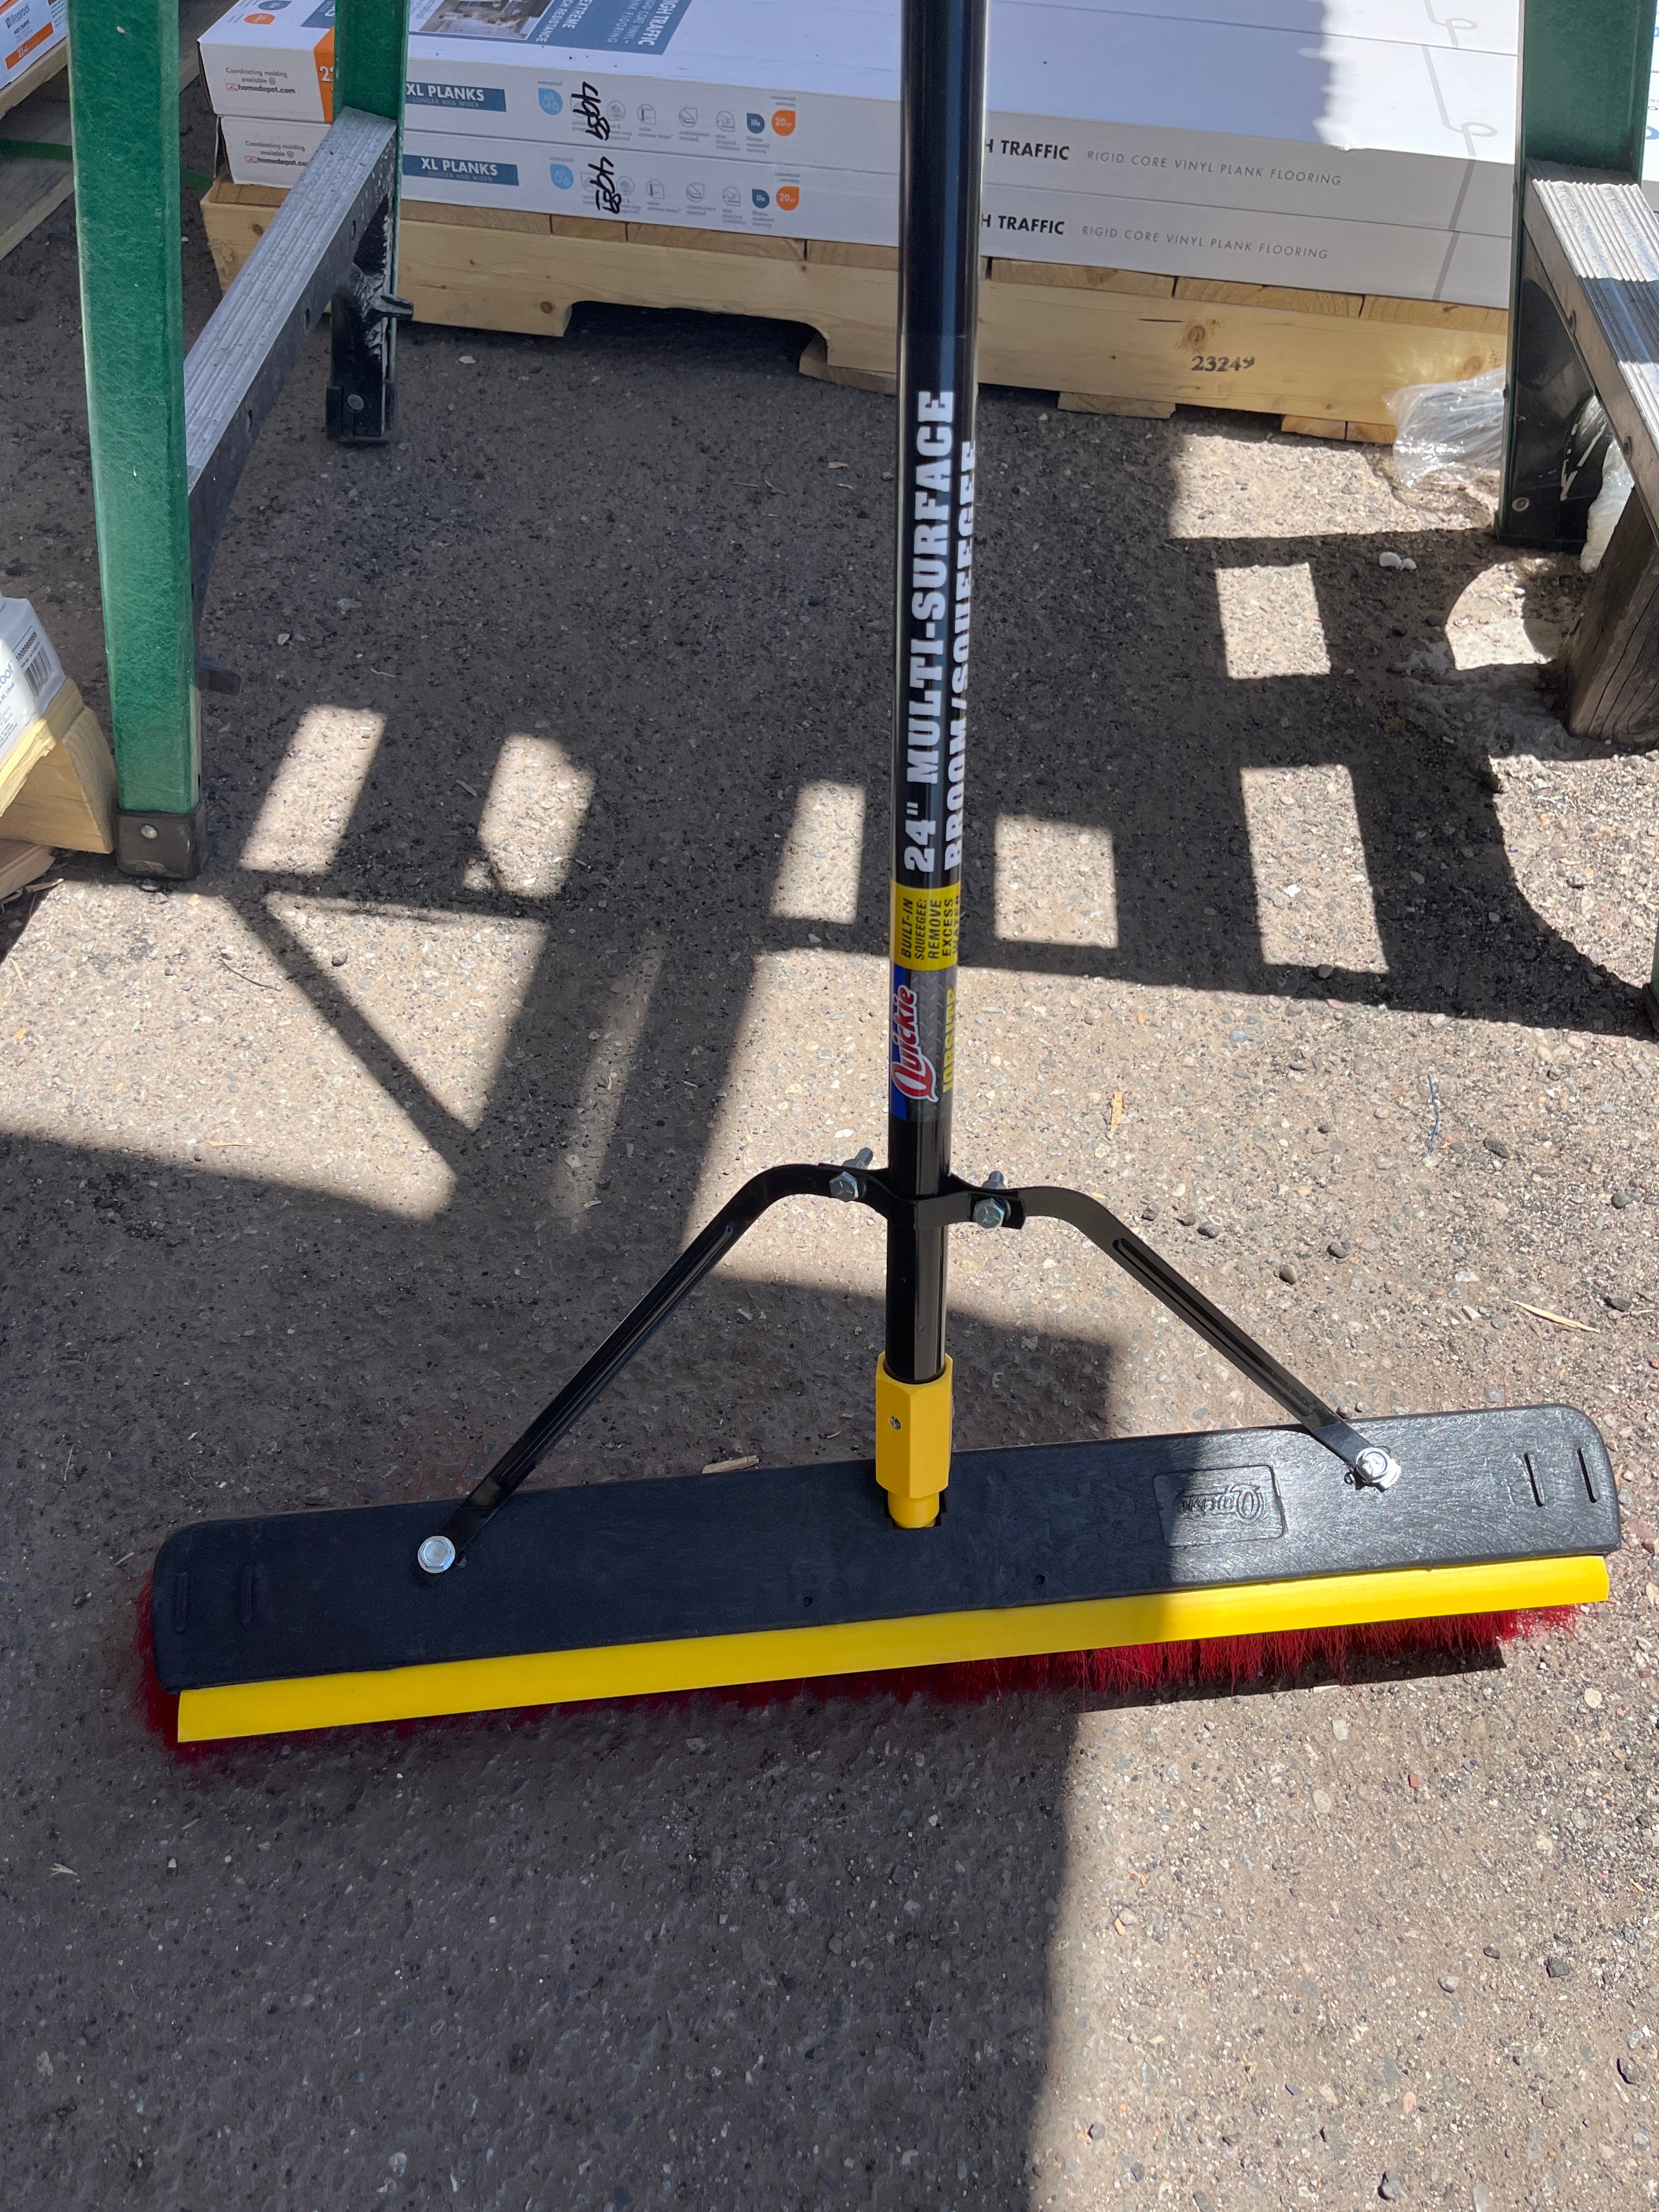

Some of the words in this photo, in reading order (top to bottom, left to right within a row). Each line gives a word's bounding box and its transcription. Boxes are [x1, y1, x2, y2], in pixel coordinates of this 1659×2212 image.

[637, 15, 670, 46] TRAFFIC
[225, 67, 263, 76] Coordinating
[238, 84, 296, 94] homedepot.com
[268, 77, 276, 85] @
[406, 83, 424, 97] XL
[427, 84, 486, 102] PLANKS
[258, 157, 310, 166] homedepot.co
[421, 157, 438, 171] XL
[442, 159, 498, 176] PLANKS
[1000, 139, 1070, 160] TRAFFIC
[1087, 150, 1124, 163] RIGID
[1131, 155, 1167, 168] CORE
[1175, 159, 1212, 173] VINYL
[1220, 163, 1263, 178] PLANK
[1270, 168, 1341, 185] FLOORING
[998, 215, 1065, 235] TRAFFIC
[1081, 225, 1118, 238] RIGID
[1124, 229, 1160, 242] CORE
[1166, 234, 1203, 247] VINYL
[1210, 238, 1251, 252] PLANK
[1259, 243, 1328, 259] FLOORING
[1191, 355, 1255, 371] 23249
[906, 391, 955, 785] MULTI-SURFACE
[903, 802, 936, 873] 24"
[900, 897, 913, 959] BUILT-IN
[927, 899, 943, 960] REMOVE
[941, 899, 954, 957] EXCESS
[890, 984, 939, 1103] Quickie
